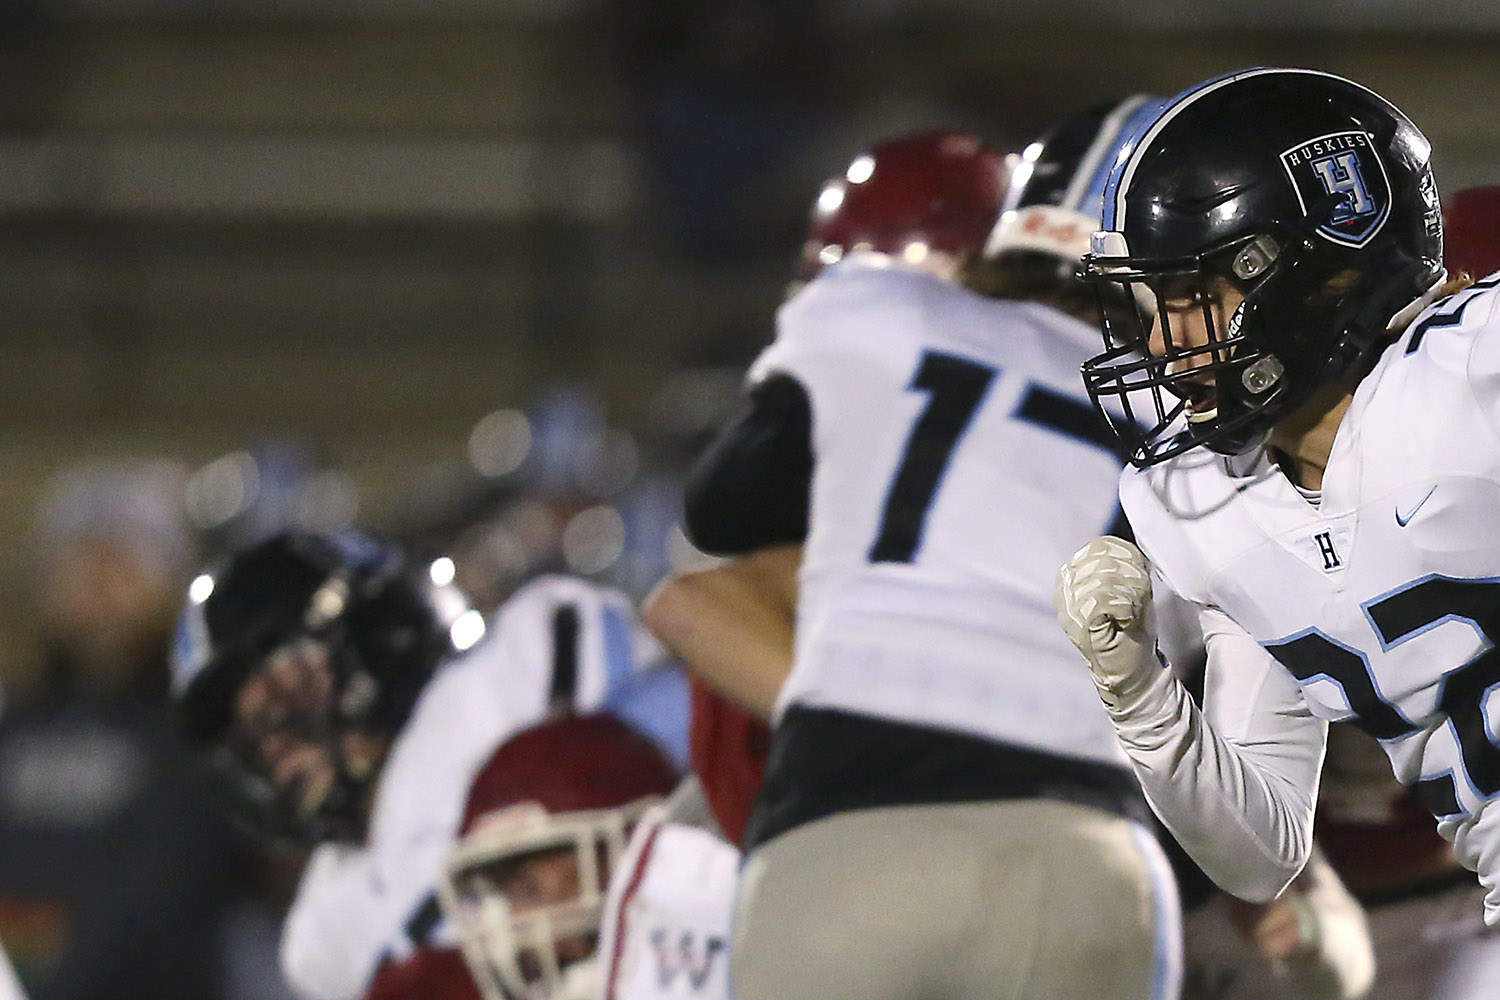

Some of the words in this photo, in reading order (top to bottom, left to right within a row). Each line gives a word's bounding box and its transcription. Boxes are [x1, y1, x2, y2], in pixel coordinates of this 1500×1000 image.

[1289, 135, 1366, 167] HUSKIES
[1314, 530, 1342, 570] H
[650, 928, 726, 992] W
